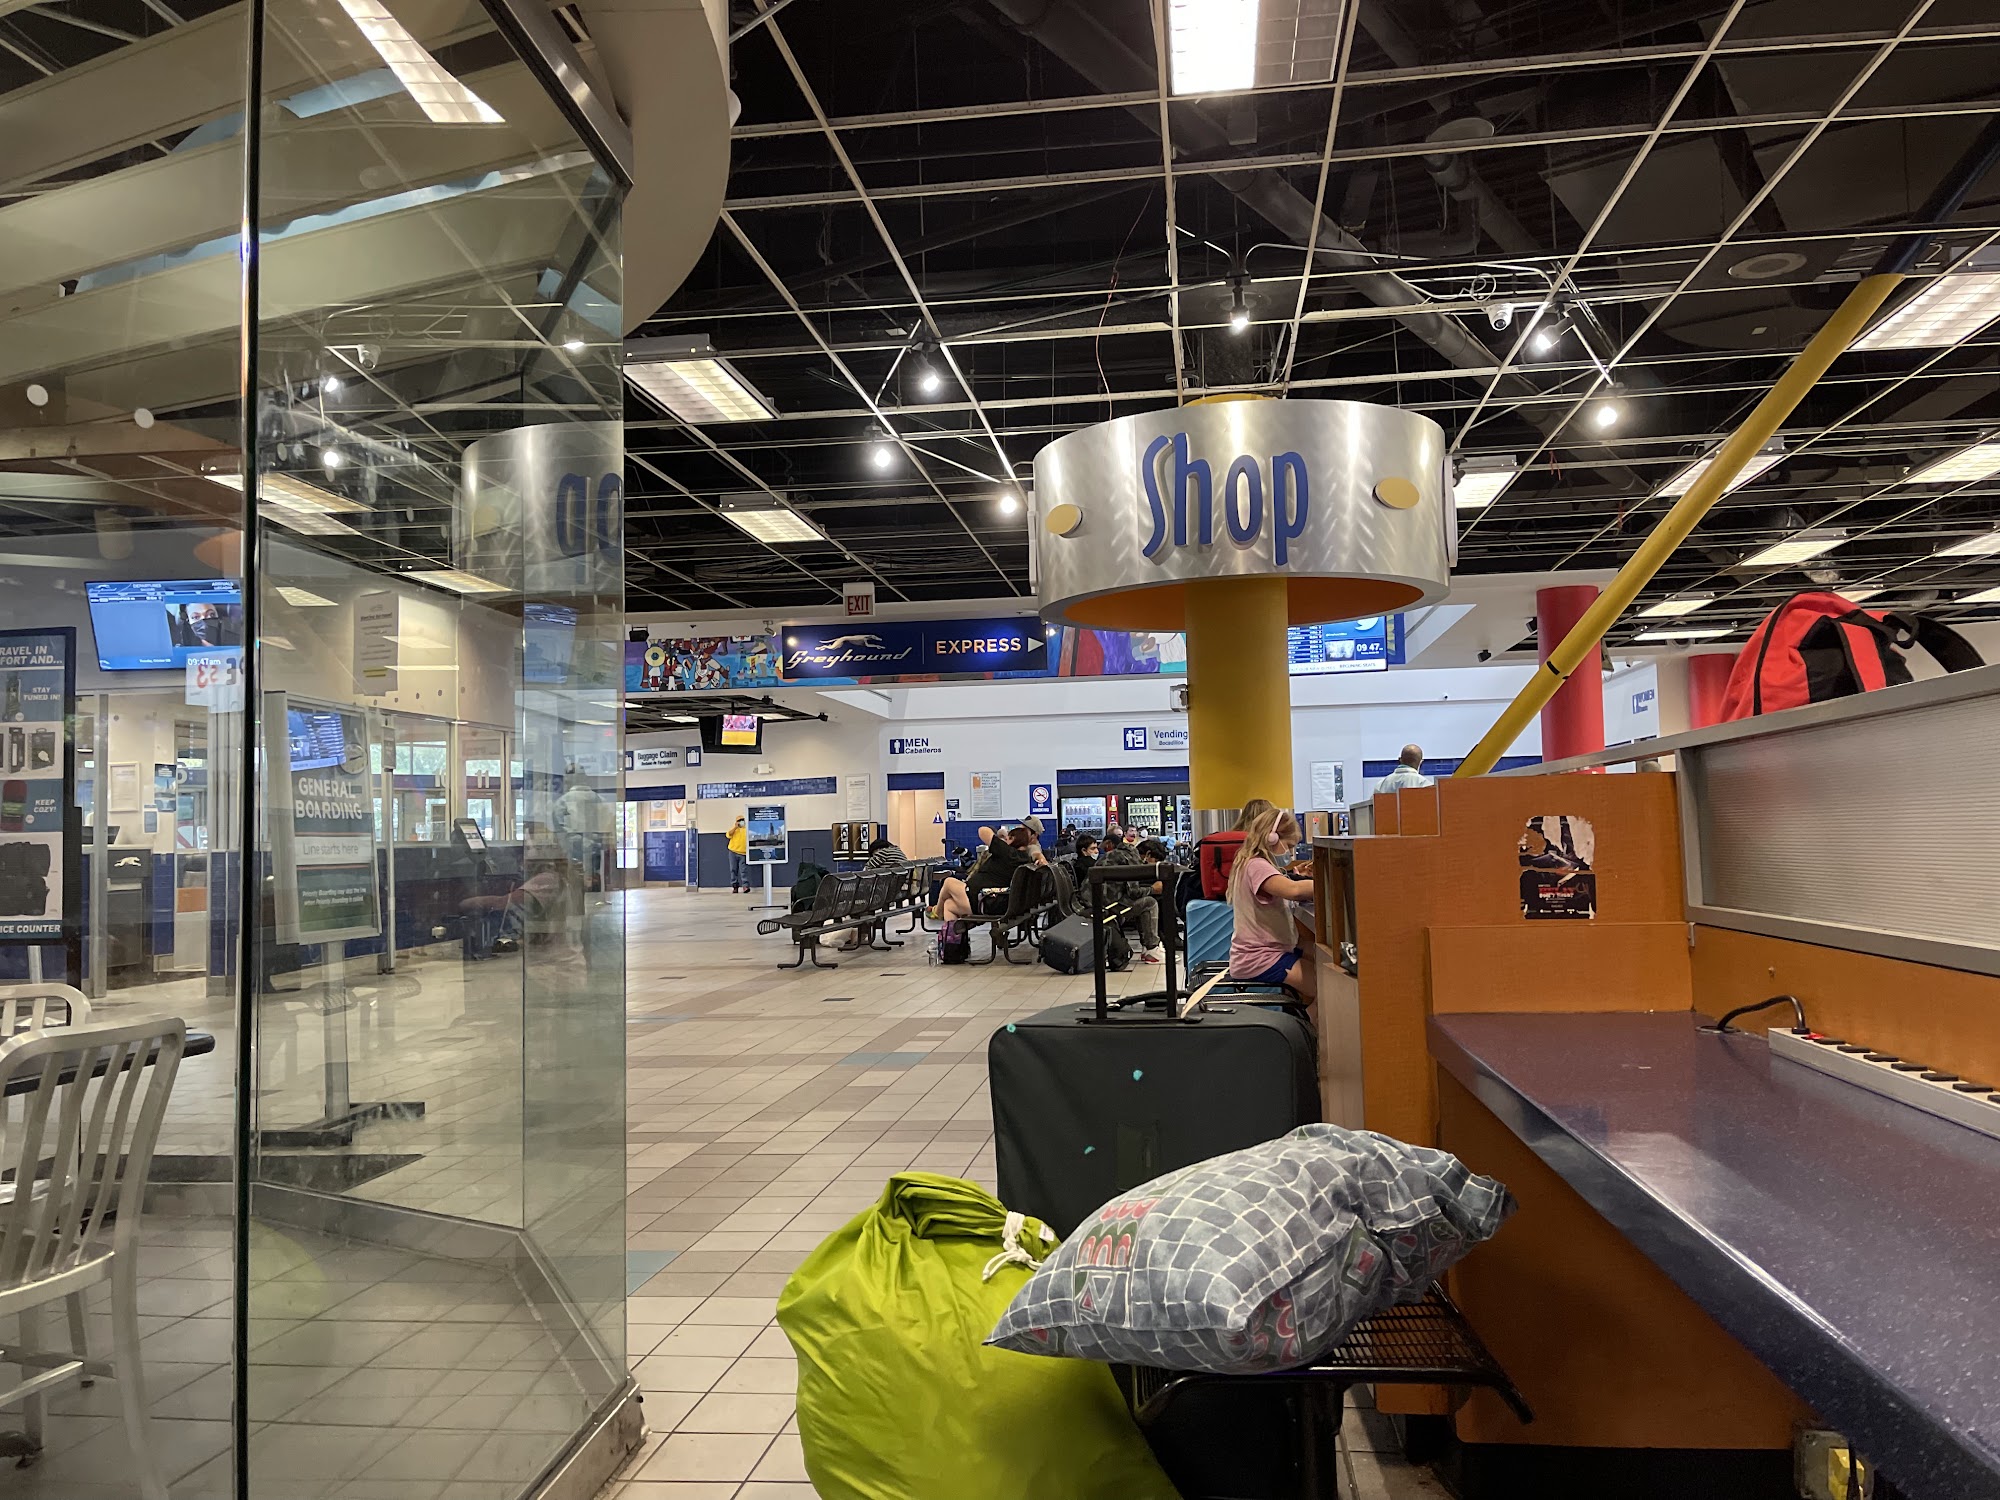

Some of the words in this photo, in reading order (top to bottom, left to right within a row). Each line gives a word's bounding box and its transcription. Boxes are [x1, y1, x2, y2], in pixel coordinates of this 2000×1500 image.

[1142, 433, 1310, 567] Shop
[847, 595, 870, 611] EXIT
[35, 645, 48, 655] IN
[785, 647, 912, 669] Greyhound
[936, 637, 1022, 655] EXPRESS
[30, 655, 63, 664] AND...
[187, 657, 222, 666] 09:47am
[1153, 730, 1188, 740] Vending
[905, 738, 929, 747] MEN
[637, 752, 659, 762] Baggage
[659, 750, 678, 759] Claim
[298, 777, 356, 798] GENERAL
[295, 800, 363, 819] BOARDING
[303, 843, 320, 855] Line
[321, 843, 341, 855] starts
[342, 842, 359, 855] here
[16, 924, 61, 933] COUNTER
